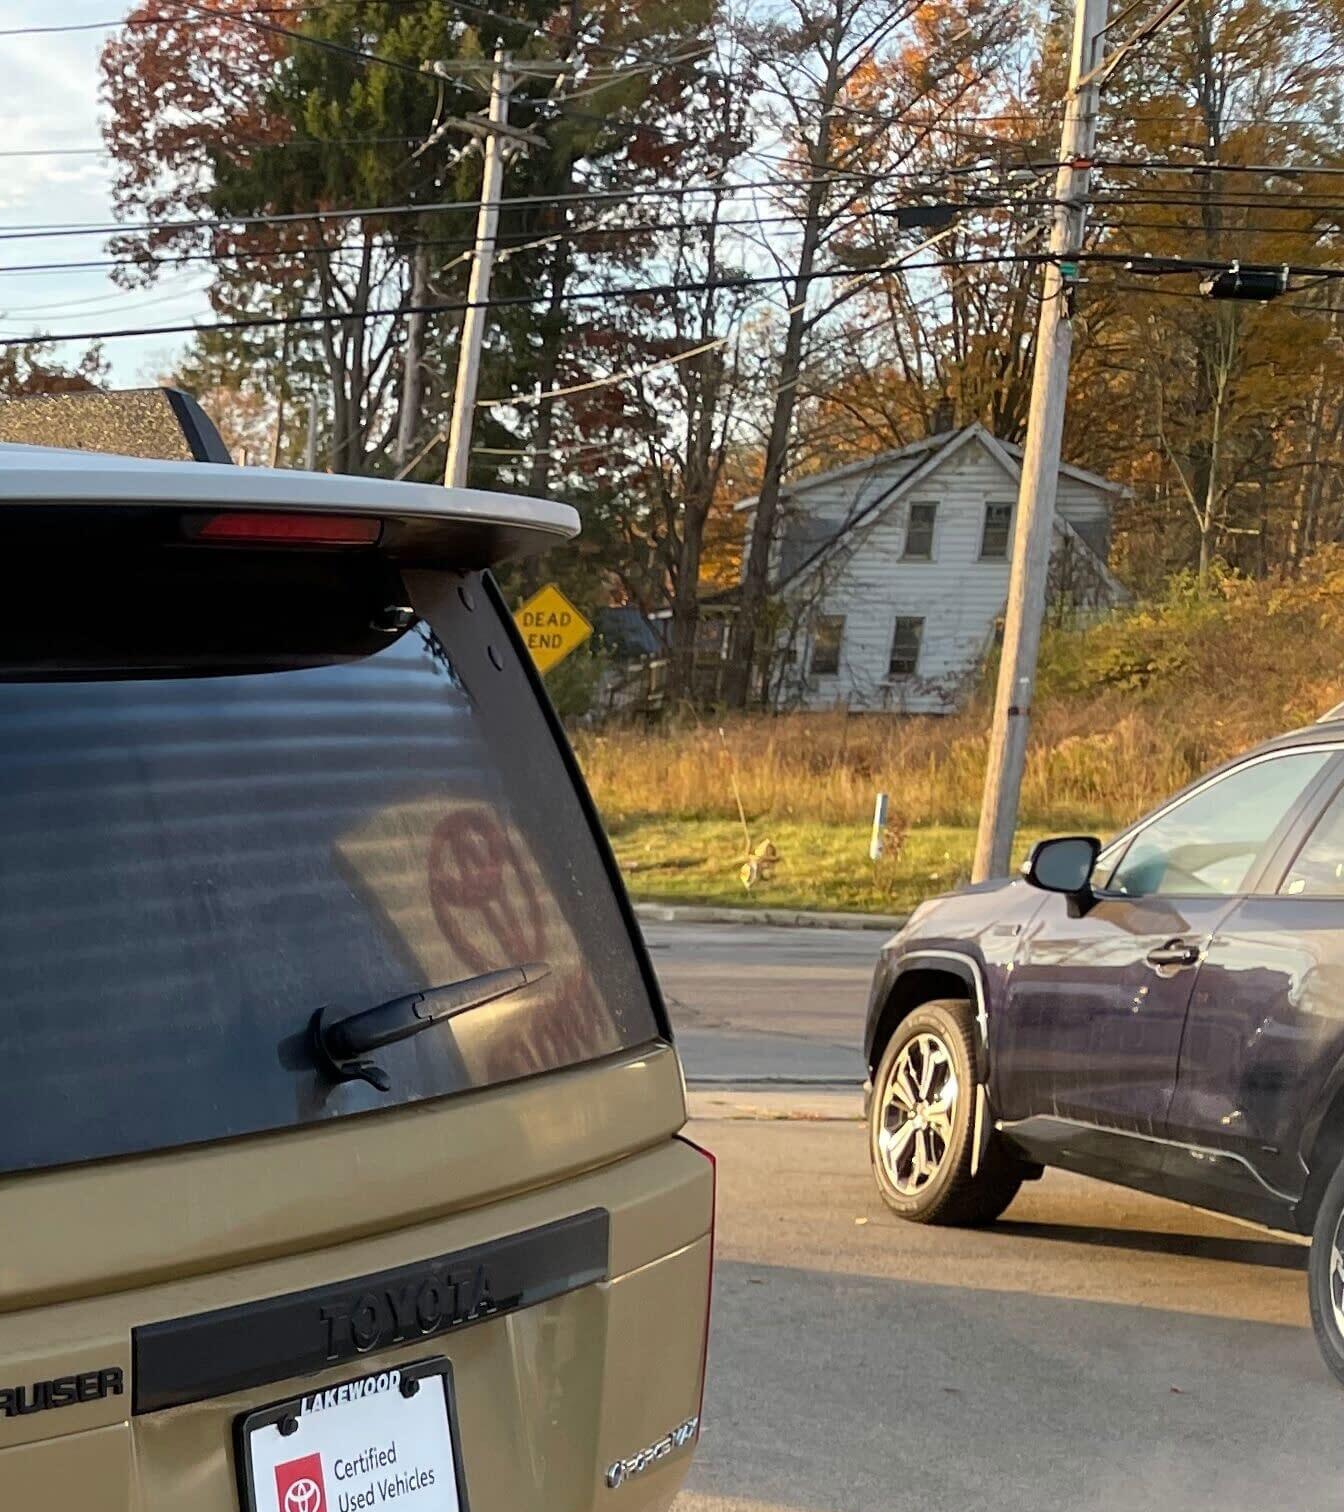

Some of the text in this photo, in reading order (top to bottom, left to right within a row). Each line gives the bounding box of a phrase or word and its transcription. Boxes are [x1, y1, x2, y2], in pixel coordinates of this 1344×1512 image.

[522, 611, 572, 628] DEAD
[527, 633, 562, 649] END
[319, 1262, 498, 1361] TOYOTA
[300, 1370, 402, 1416] LAKEWOOD
[333, 1440, 397, 1481] Certified
[377, 1466, 436, 1502] Vehicles
